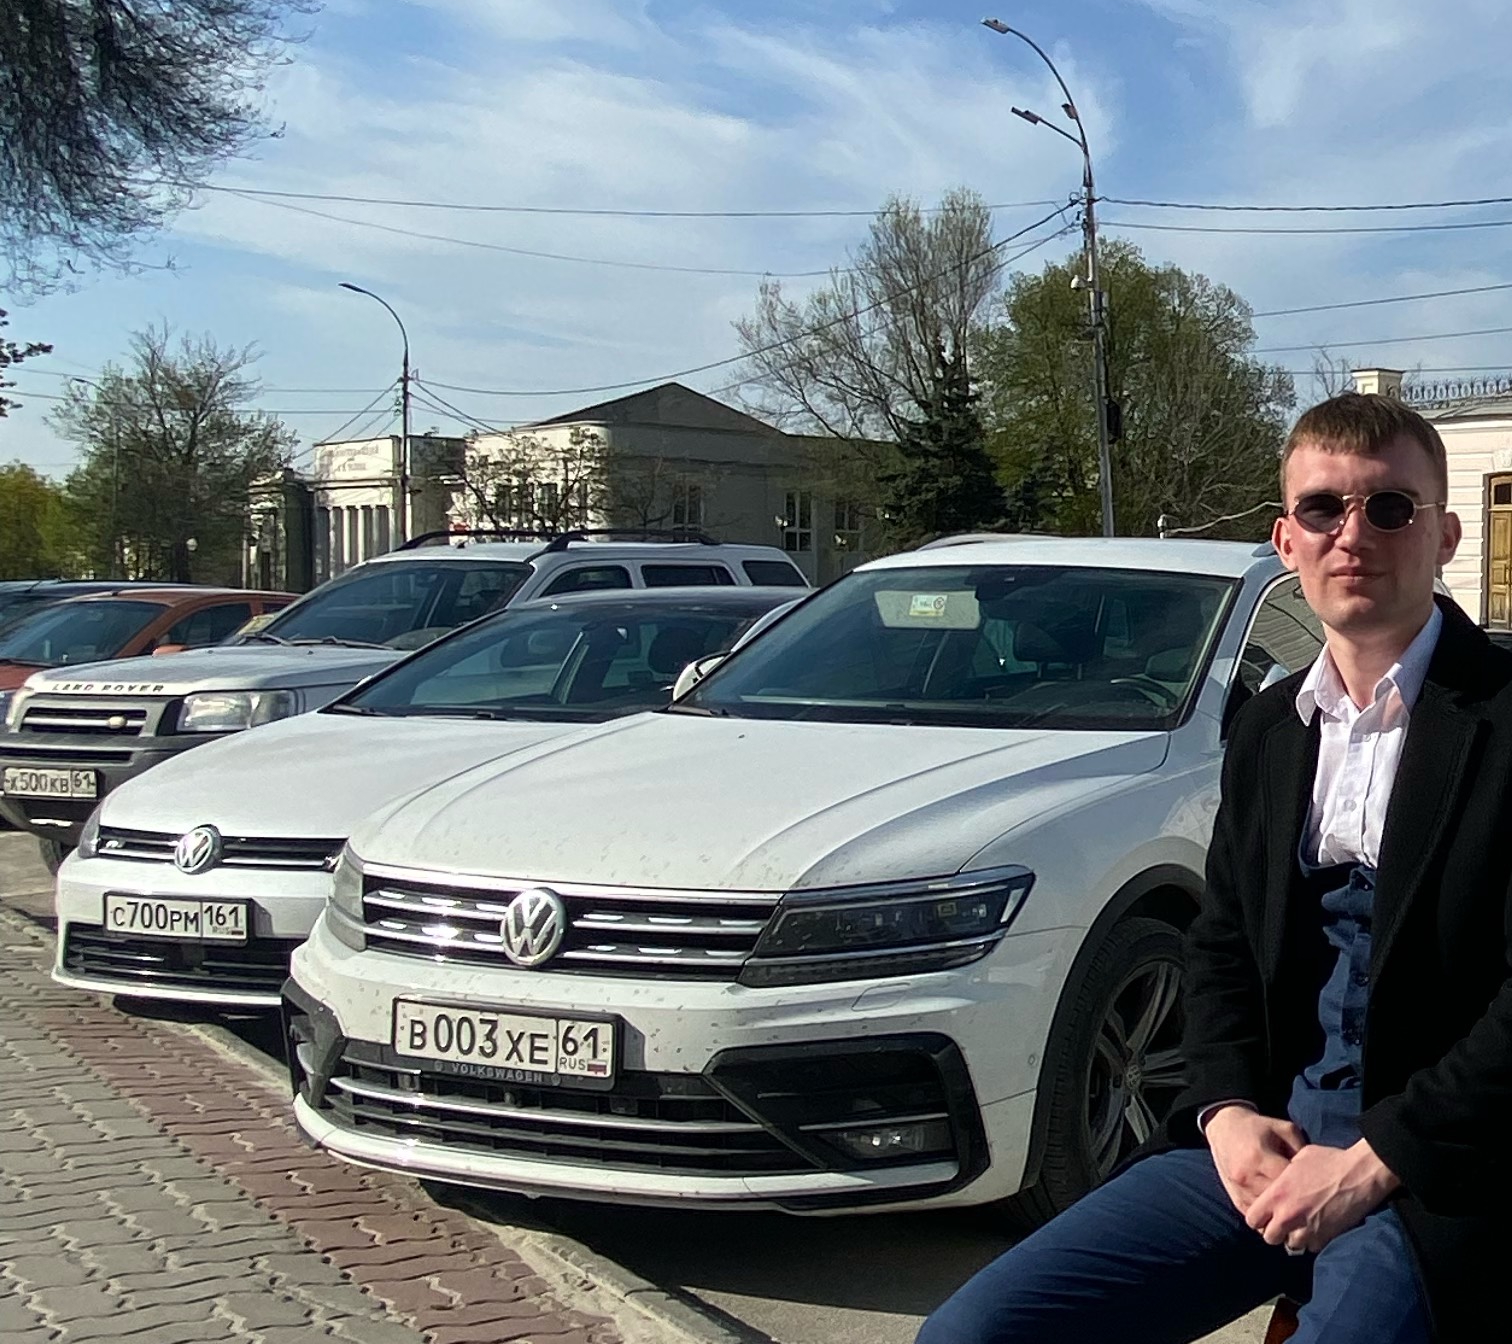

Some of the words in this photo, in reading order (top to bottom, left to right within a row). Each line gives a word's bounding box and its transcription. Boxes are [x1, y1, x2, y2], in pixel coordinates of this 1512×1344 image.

[73, 770, 93, 788] 61
[113, 901, 200, 932] С700РМ
[204, 905, 239, 928] 161
[409, 1013, 549, 1065] В003ХЕ
[561, 1025, 599, 1059] 61
[452, 1062, 543, 1083] VOLKSWAGEN
[559, 1056, 586, 1070] RUS
